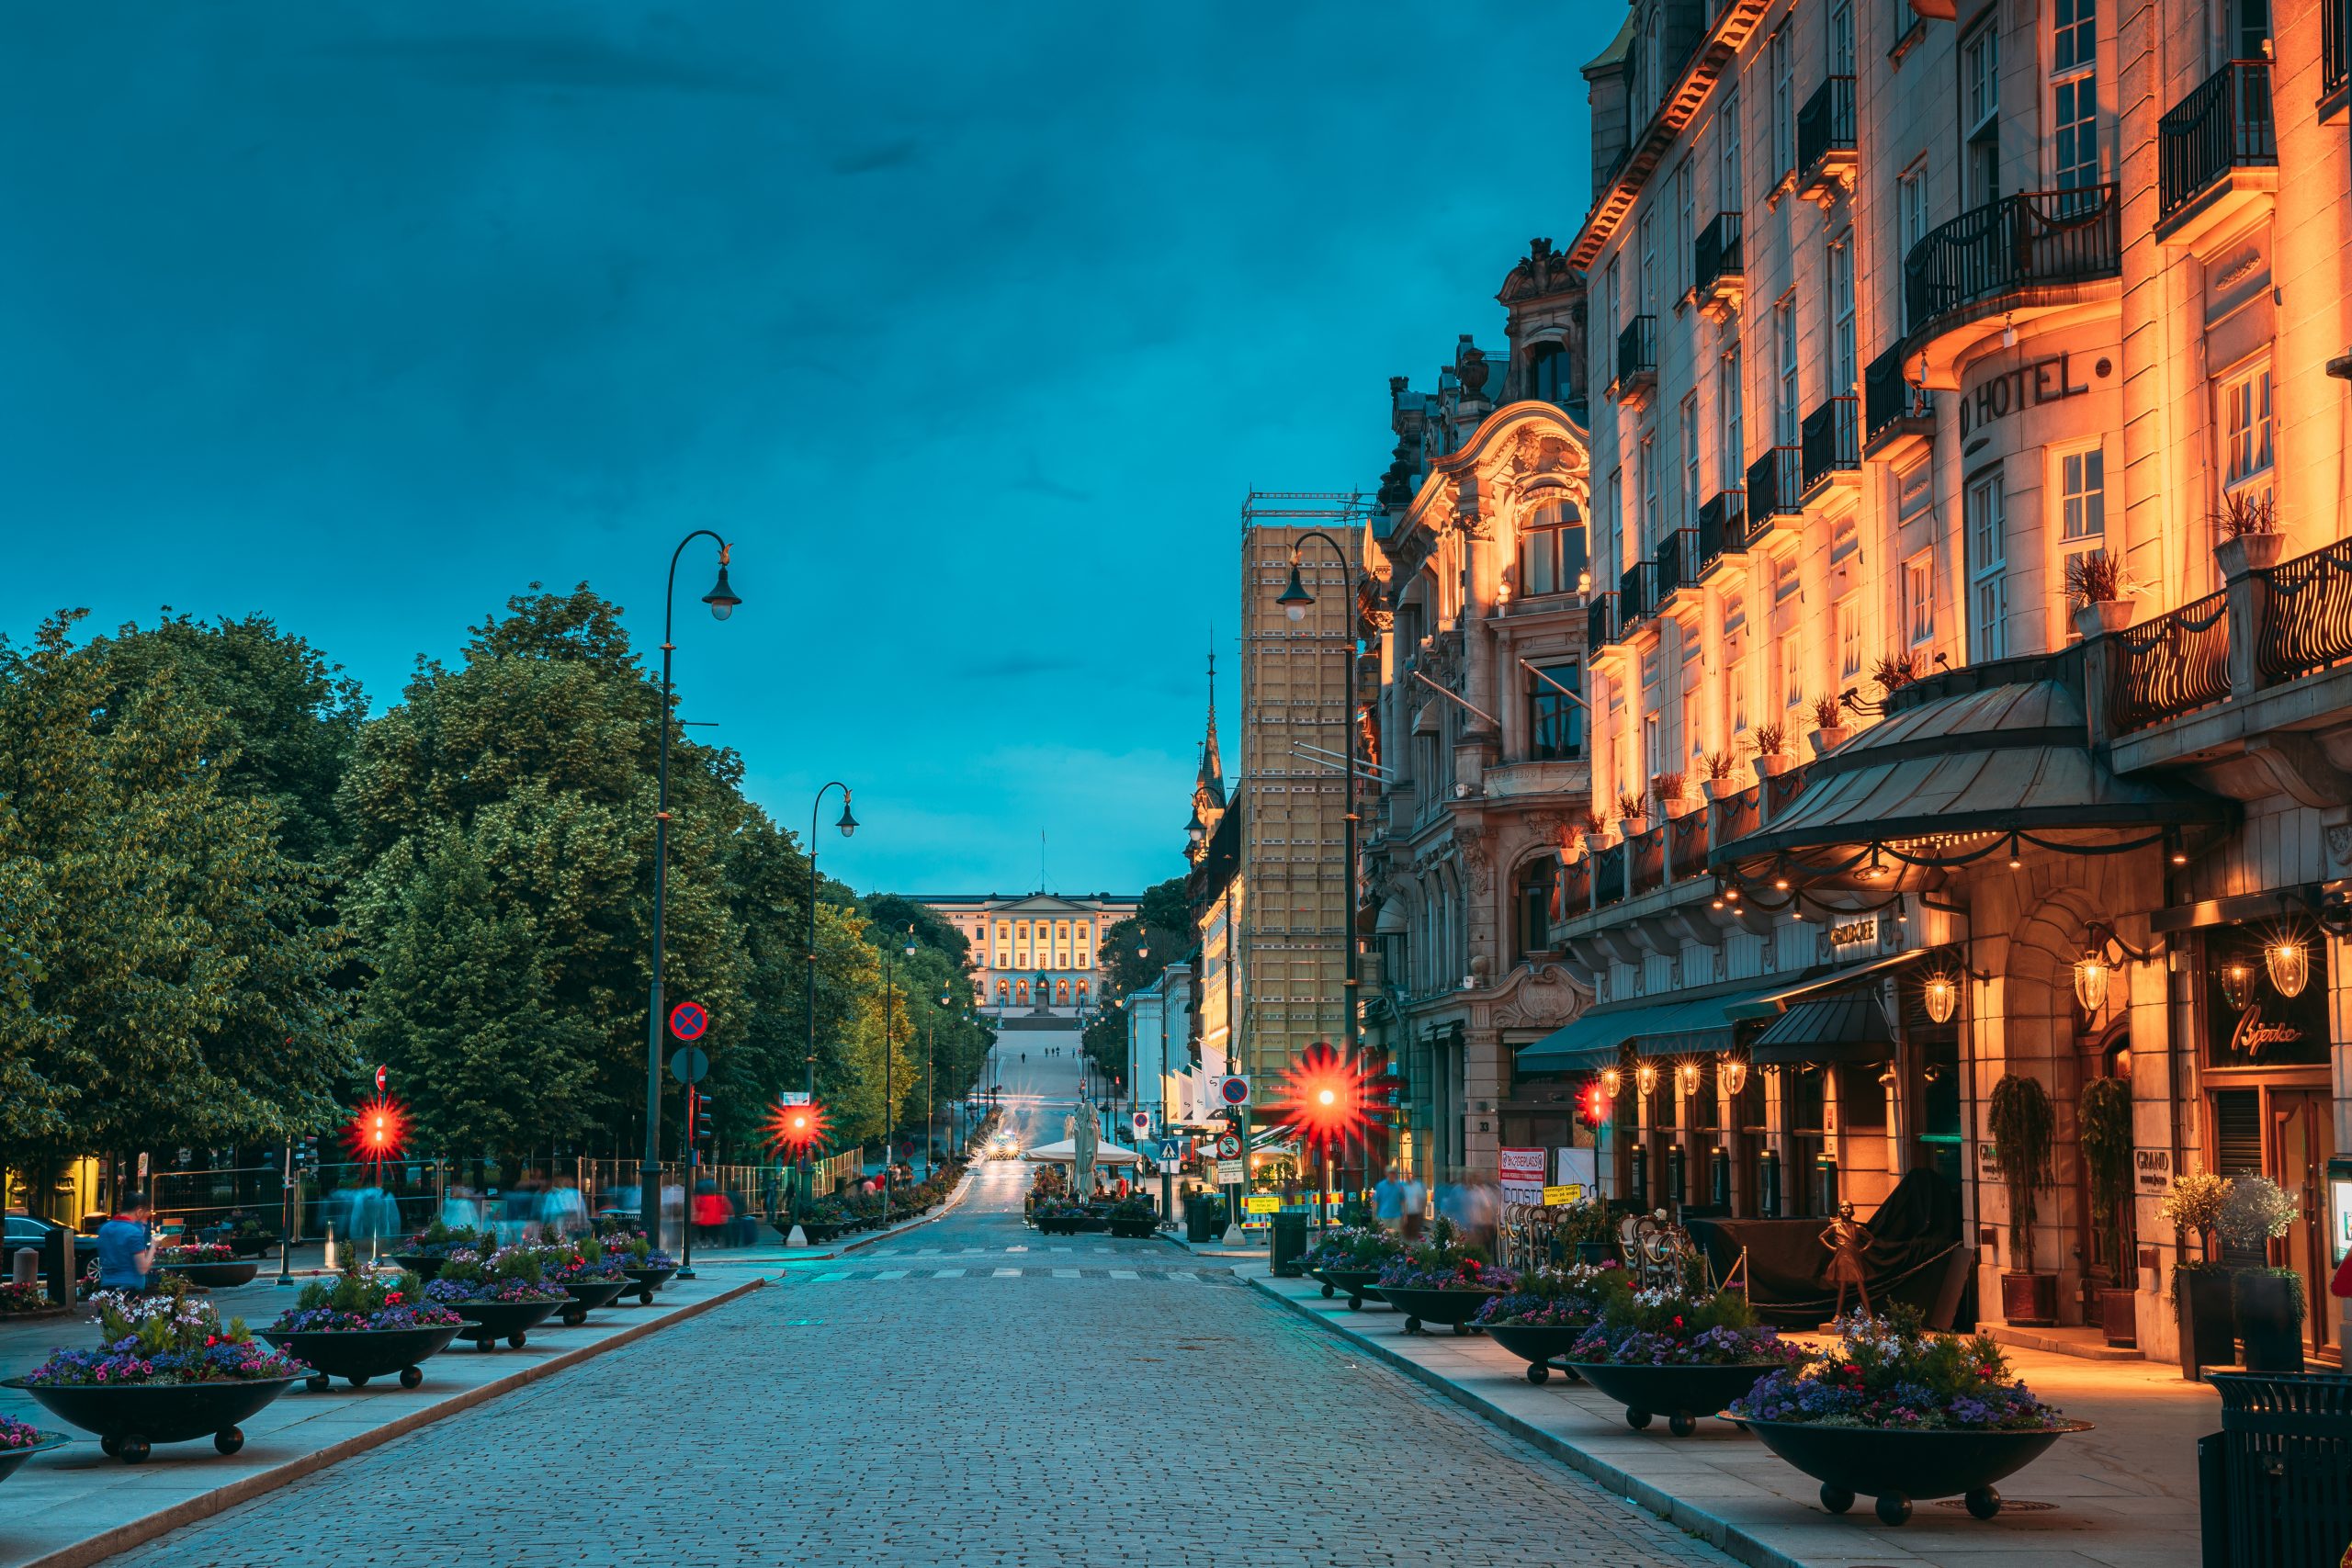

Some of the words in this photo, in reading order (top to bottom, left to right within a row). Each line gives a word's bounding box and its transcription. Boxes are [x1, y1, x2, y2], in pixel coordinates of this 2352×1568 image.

[1976, 348, 2089, 428] HOTEL
[1479, 1121, 1489, 1133] 33
[2136, 1150, 2169, 1170] GRAND
